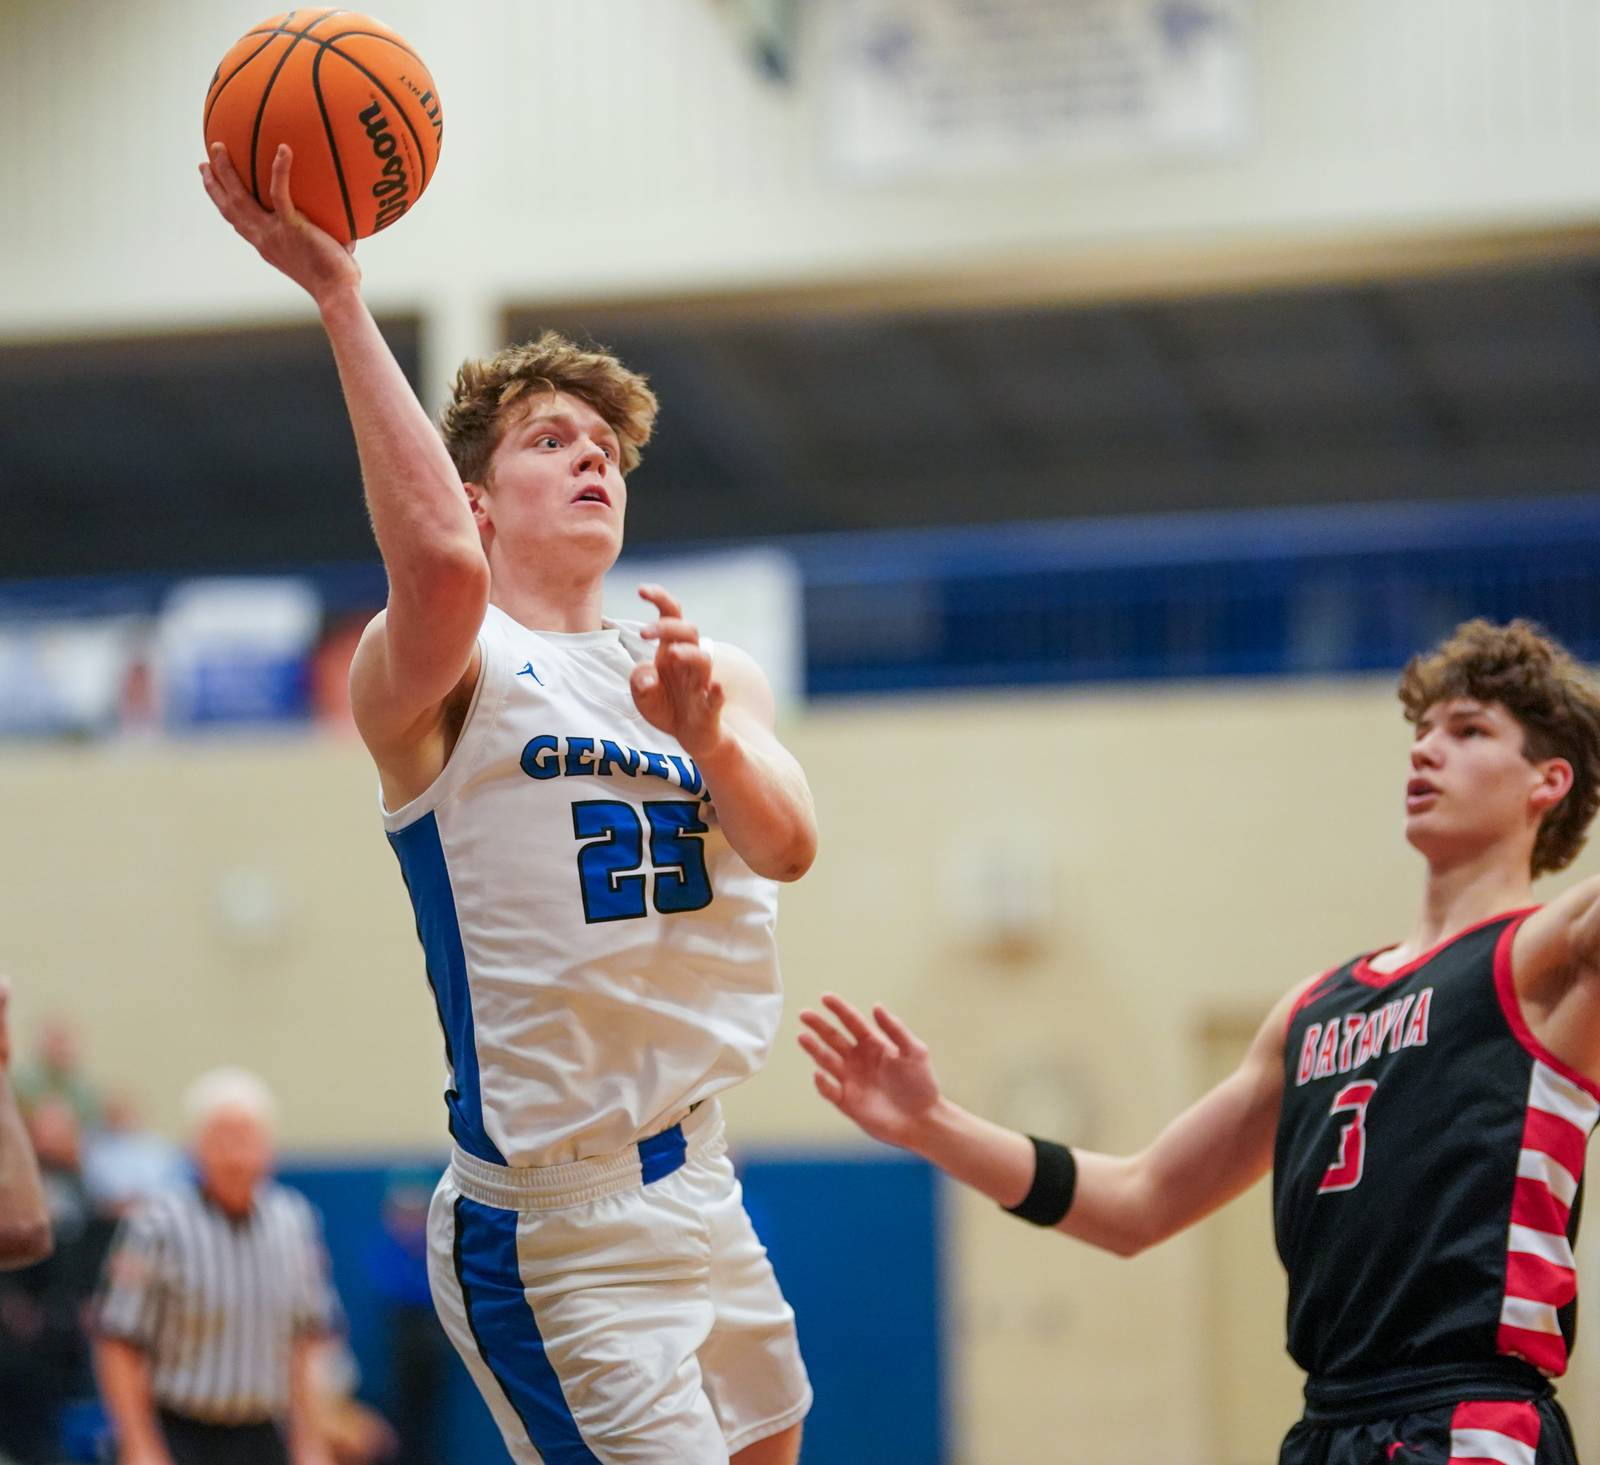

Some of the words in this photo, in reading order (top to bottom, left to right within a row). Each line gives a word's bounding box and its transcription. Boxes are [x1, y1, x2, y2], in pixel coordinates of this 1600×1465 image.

[358, 100, 409, 234] Wilson
[519, 734, 712, 803] GENEV
[571, 799, 713, 924] 25
[1295, 987, 1434, 1087] BATAVIA
[1317, 1079, 1378, 1195] 3
